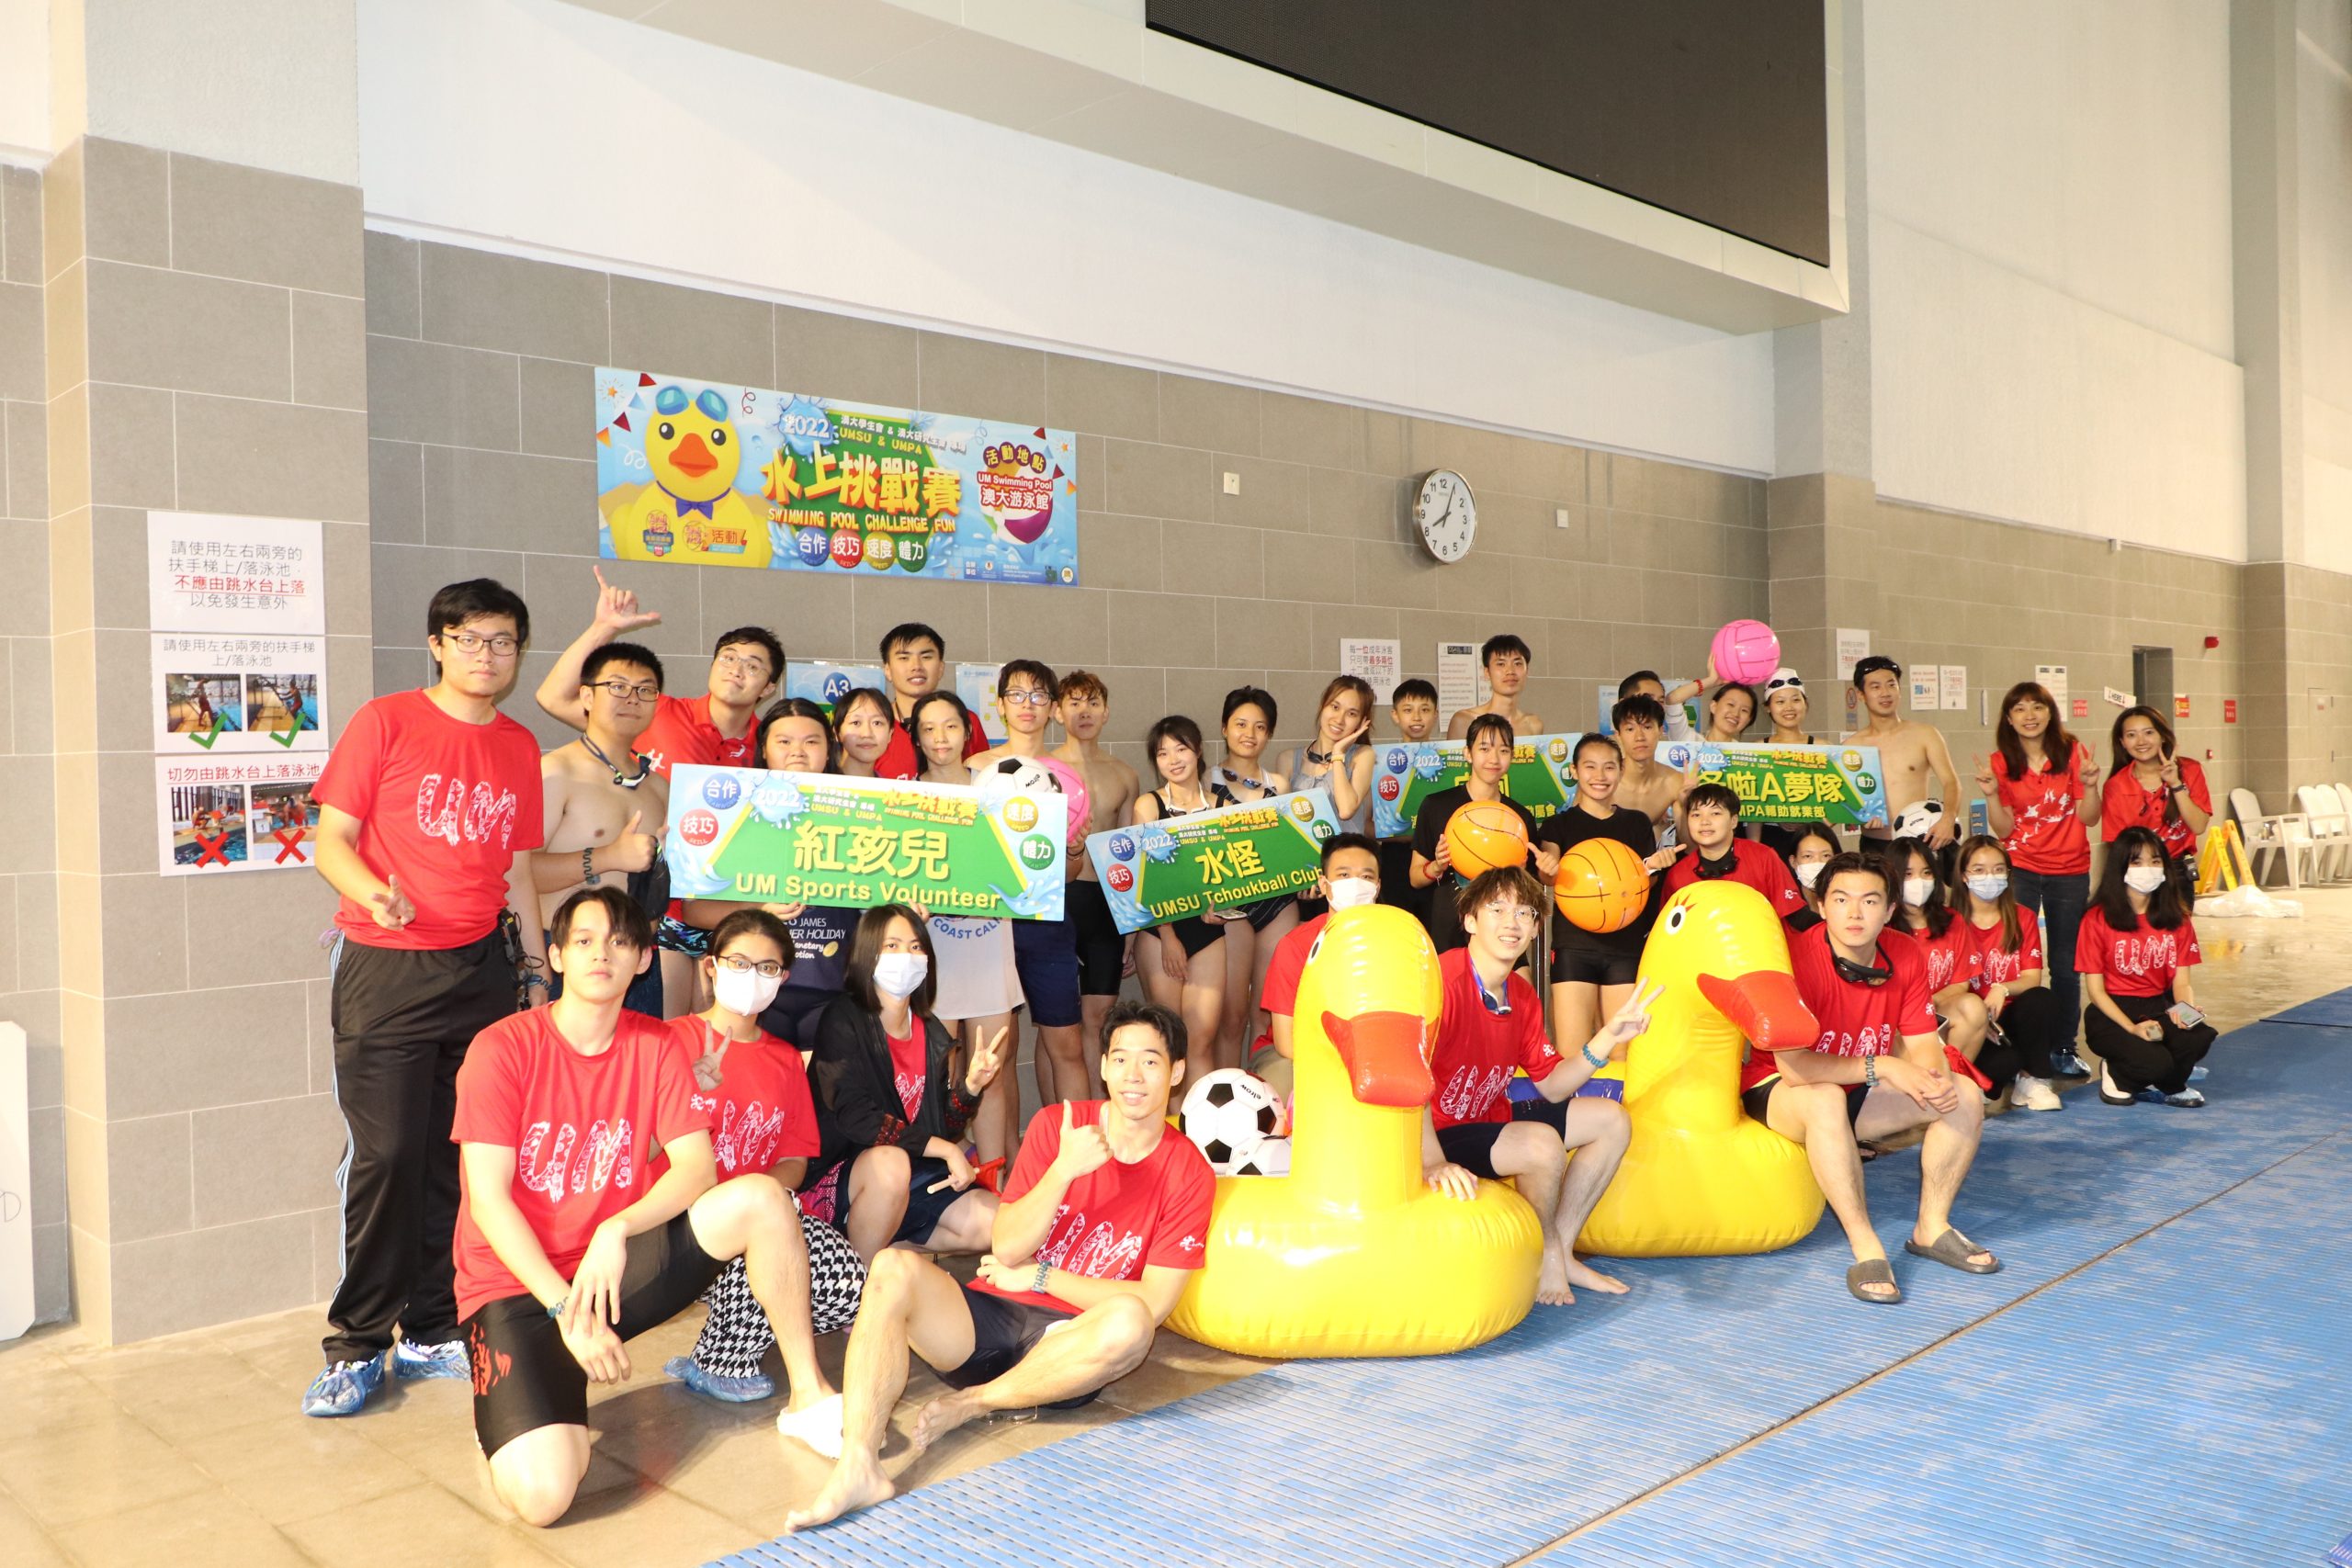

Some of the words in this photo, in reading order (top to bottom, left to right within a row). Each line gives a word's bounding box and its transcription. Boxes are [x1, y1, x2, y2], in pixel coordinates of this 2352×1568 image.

[783, 413, 830, 438] 2022
[840, 427, 872, 444] UMSU
[877, 436, 886, 446] &
[891, 439, 922, 455] UMPA
[986, 445, 1045, 472] 活動地點
[760, 441, 962, 518] 水上挑戰賽
[978, 473, 990, 482] UM
[993, 476, 1032, 489] Swimming
[1035, 479, 1052, 490] Pool
[1430, 483, 1436, 492] 11
[1440, 479, 1447, 489] 12
[982, 487, 1049, 510] 澳大游泳館
[1423, 494, 1430, 503] 10
[1459, 498, 1464, 508] 2
[768, 508, 826, 528] SWIMMING
[830, 512, 860, 530] POOL
[865, 513, 929, 533] CHALLENGE
[933, 517, 956, 534] FUN
[1421, 510, 1425, 519] 9
[1463, 515, 1467, 525] 3
[712, 529, 738, 544] 活動
[1425, 526, 1430, 536] 8
[1460, 531, 1464, 540] 4
[171, 540, 302, 561] 請使用左右兩旁的
[799, 533, 826, 555] 合作
[833, 536, 860, 556] 技巧
[867, 538, 892, 558] 速度
[899, 540, 924, 560] 體力
[1432, 540, 1437, 549] 7
[1442, 546, 1447, 556] 6
[1453, 543, 1457, 551] 5
[175, 575, 305, 594] 不應由跳水台上落
[190, 594, 288, 610] 以免發生意外
[164, 638, 315, 653] 請使用左右兩旁的扶手梯
[212, 654, 272, 667] 上/落泳池
[824, 679, 850, 696] A3
[1550, 742, 1566, 755] 速度
[1670, 750, 1689, 761] 合作
[1388, 753, 1406, 766] 合作
[1416, 755, 1441, 766] 2022
[1698, 753, 1725, 763] 2022
[167, 763, 321, 782] 切勿由跳水台上落泳池
[706, 780, 738, 799] 合作
[1380, 780, 1396, 793] 技巧
[756, 789, 800, 807] 2022
[417, 773, 516, 850] UM
[811, 803, 839, 814] UMSU
[855, 810, 882, 821] UMPA
[1007, 803, 1035, 822] 速度
[1292, 802, 1312, 815] 速度
[684, 817, 714, 835] 技巧
[1313, 824, 1332, 839] 體力
[794, 819, 950, 881] 紅孩兒
[1023, 840, 1051, 860] 體力
[1111, 838, 1133, 853] 合作
[1143, 834, 1173, 851] 2022
[1195, 840, 1265, 885] 水怪
[1108, 868, 1130, 885] 技巧
[736, 873, 776, 895] UM
[785, 875, 870, 900] Sports
[879, 882, 1001, 908] Volunteer
[1150, 895, 1201, 919] UMSU
[1203, 874, 1288, 904] Tchoukball
[1291, 865, 1323, 886] Club
[799, 918, 827, 927] JAMES
[933, 919, 972, 939] COAST
[790, 930, 805, 939] ER
[807, 929, 846, 939] HOLIDAY
[794, 941, 824, 953] anetary
[2114, 934, 2177, 976] UM
[1240, 1084, 1261, 1100] elrow
[520, 1118, 632, 1203] UM
